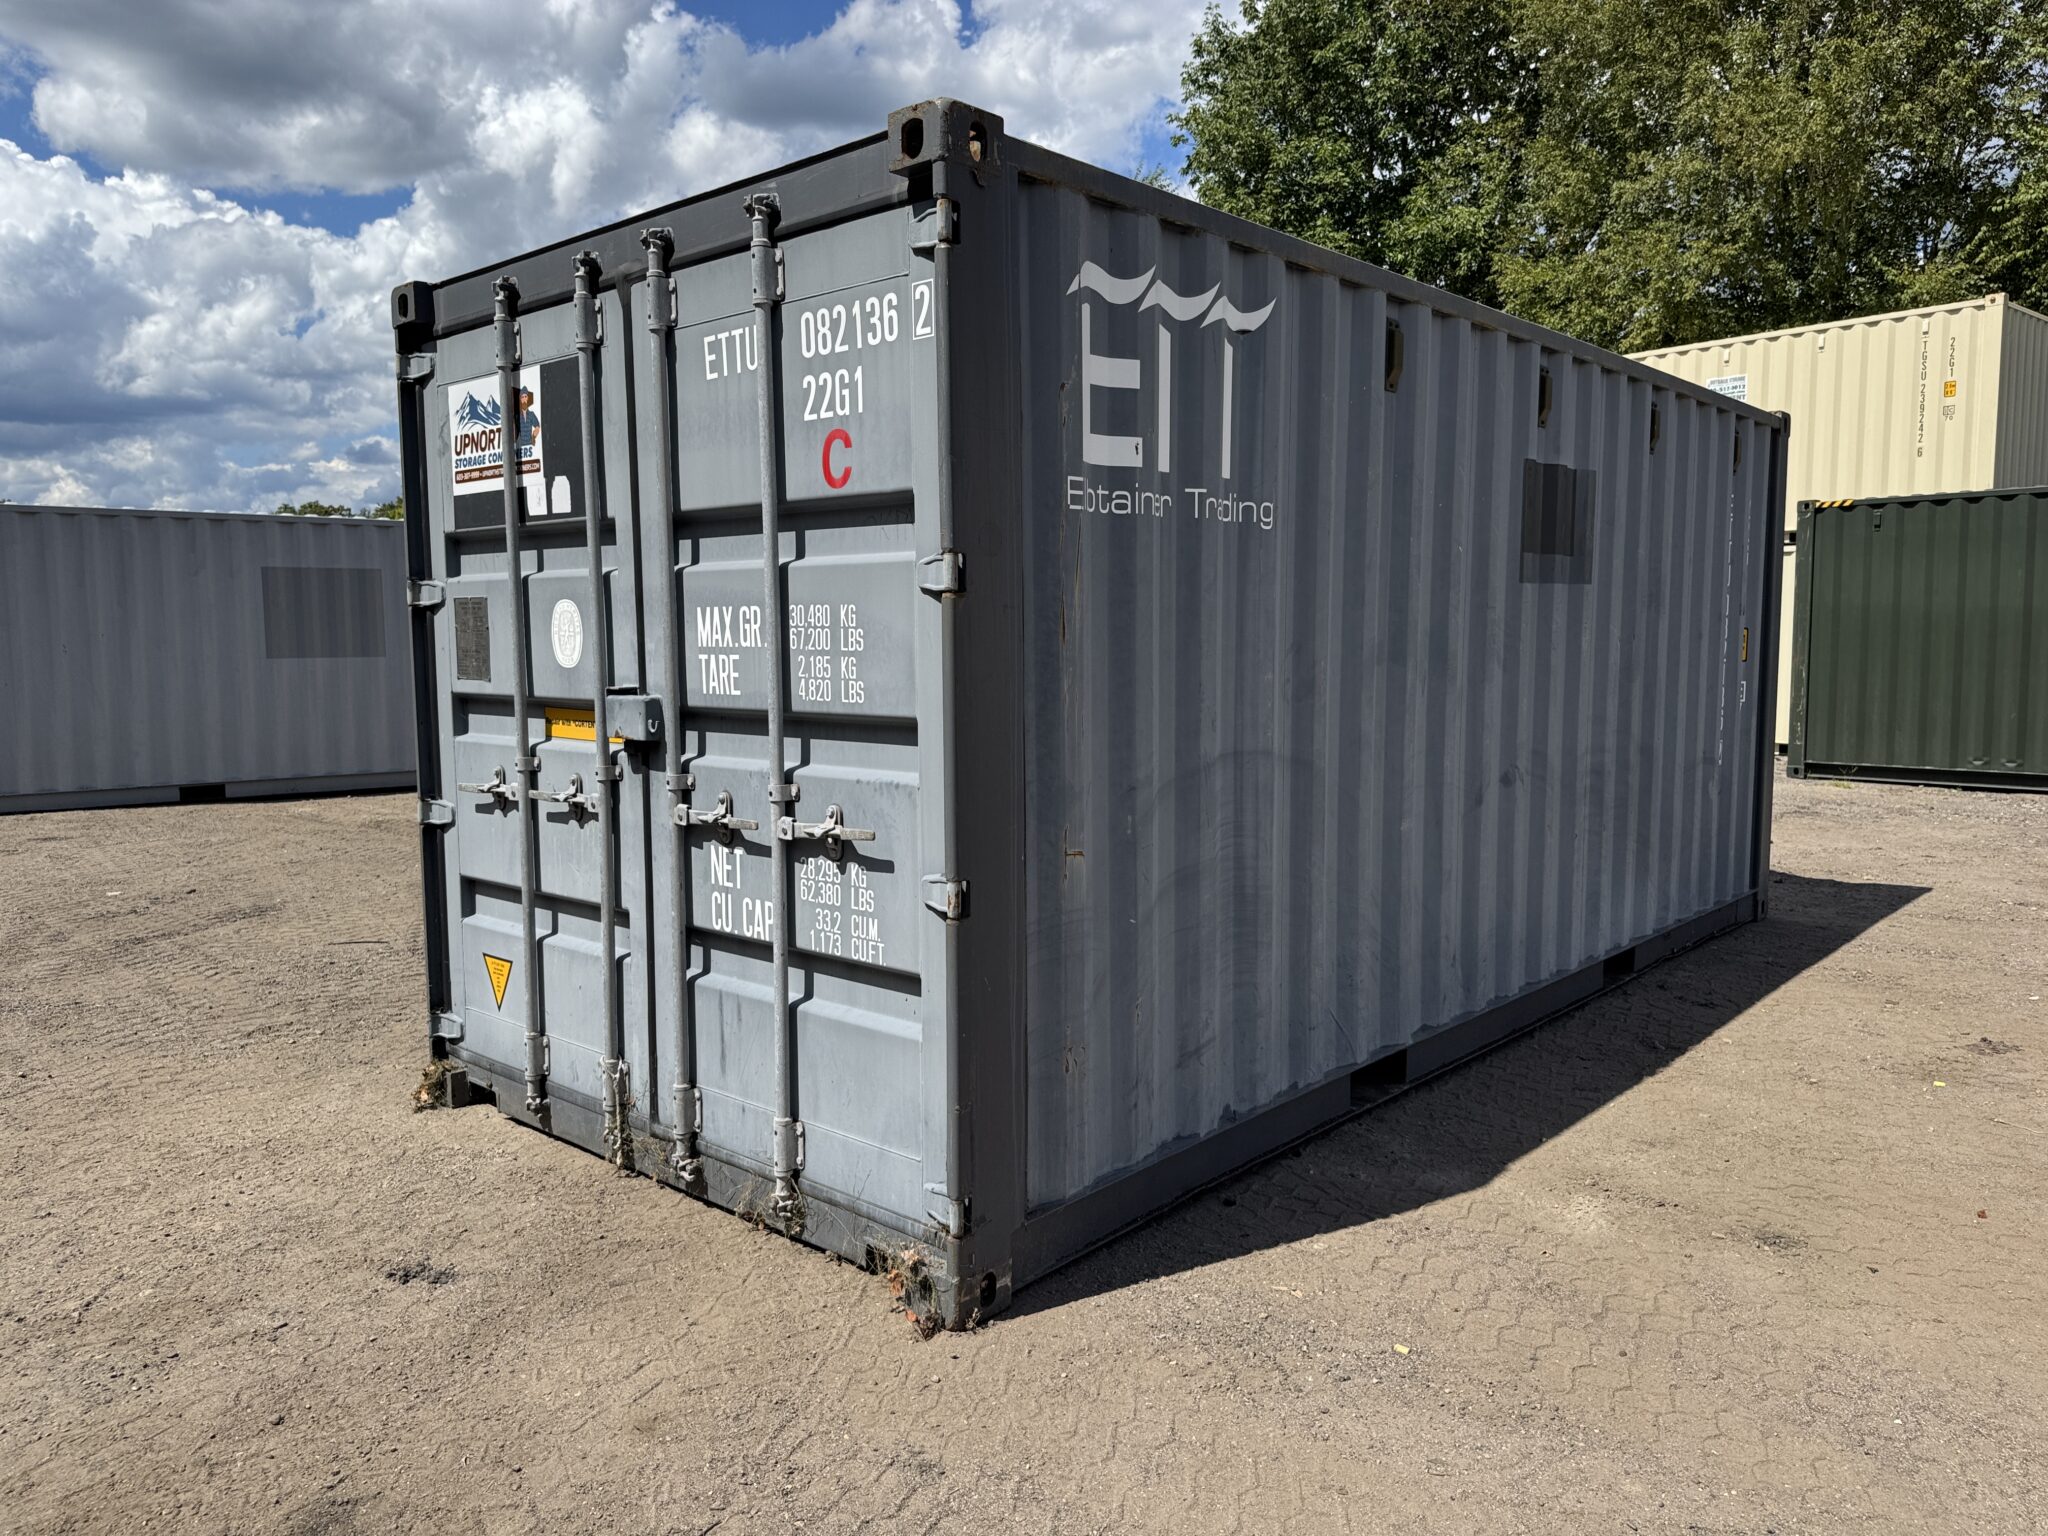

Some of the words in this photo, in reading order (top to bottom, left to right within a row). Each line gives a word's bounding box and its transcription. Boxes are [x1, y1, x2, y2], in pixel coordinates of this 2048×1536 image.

[704, 324, 758, 381] ETTU
[800, 292, 899, 359] 082136
[914, 284, 932, 337] 2
[1920, 340, 1929, 381] TGSU
[1948, 336, 1956, 378] 22G1
[802, 365, 865, 422] 22G1
[1917, 383, 1926, 444] 239242
[454, 427, 504, 457] UPNORT
[822, 428, 853, 489] C
[454, 454, 486, 470] STORAGE
[1184, 488, 1275, 530] Trading
[697, 605, 768, 649] MAX.GR.
[789, 604, 831, 628] 30,480
[840, 604, 857, 628] KG
[789, 628, 831, 651] 67,200
[840, 628, 865, 651] LBS
[698, 654, 742, 696] TARE
[798, 655, 831, 679] 2,185
[840, 656, 857, 680] KG
[798, 678, 832, 702] 4,820
[841, 680, 865, 704] LBS
[710, 844, 744, 890] NET
[800, 856, 841, 884] 28,295
[850, 863, 867, 889] KG
[800, 879, 842, 907] 62,380
[850, 887, 875, 913] LBS
[810, 929, 842, 956] 1,173
[815, 908, 842, 934] 33.2
[850, 915, 881, 942] CU.M.
